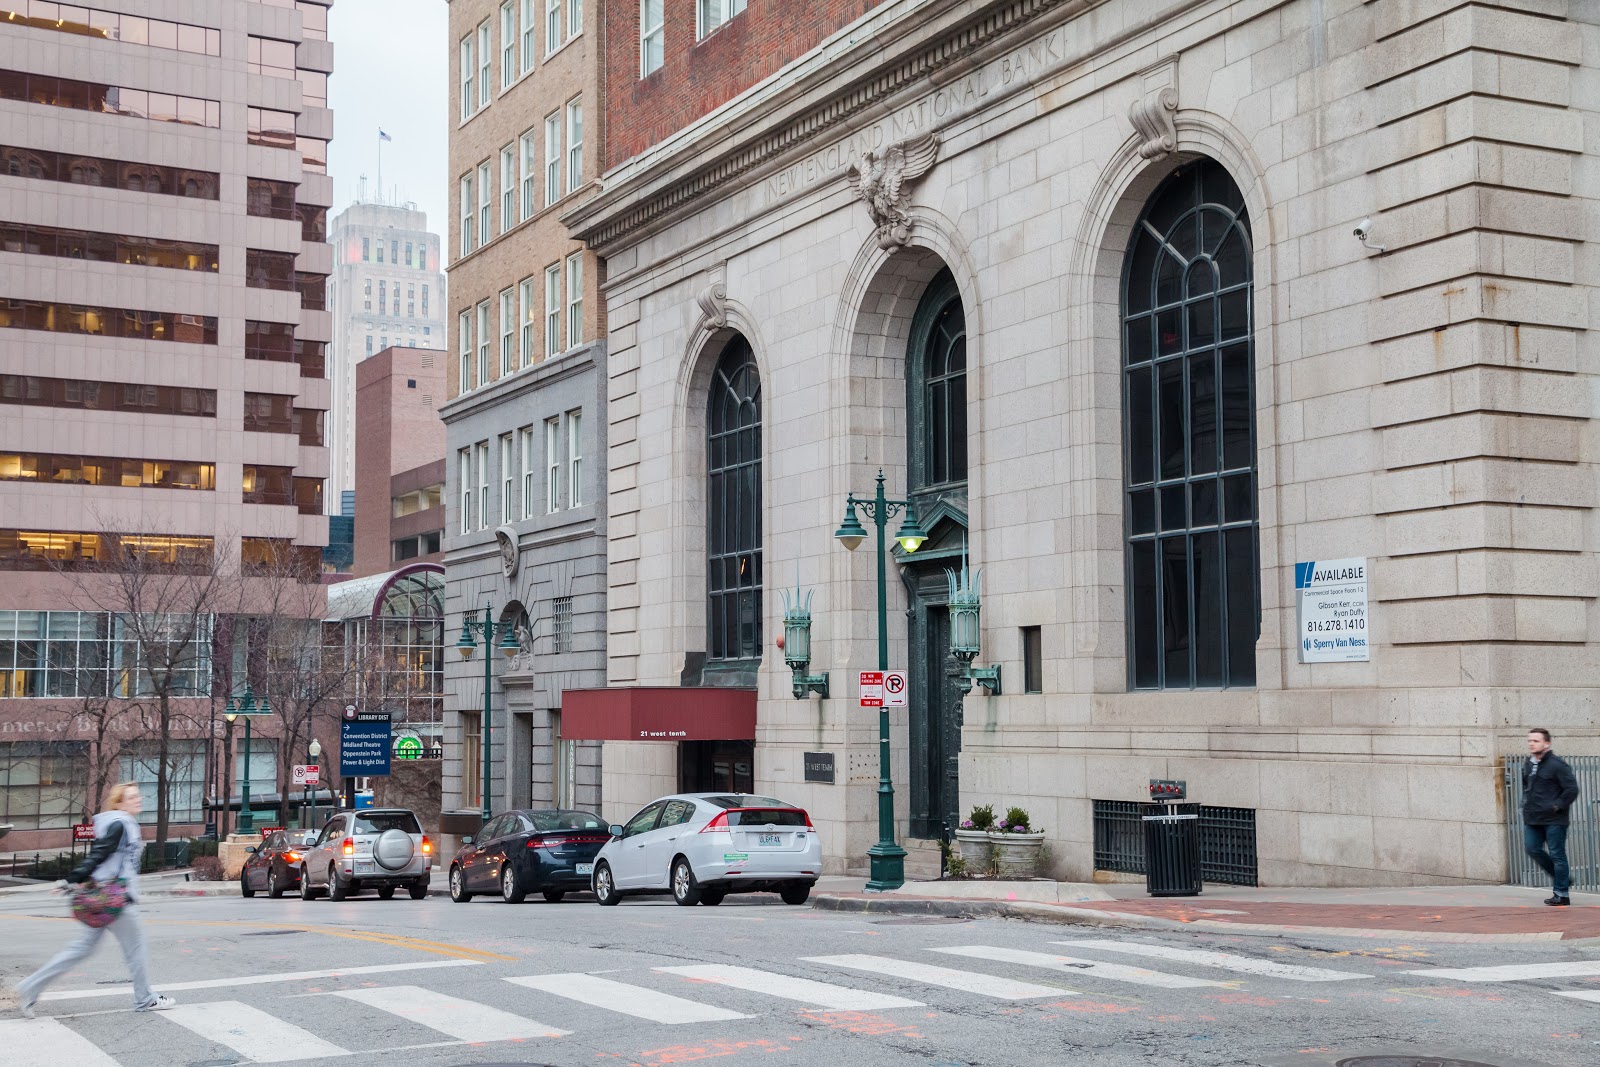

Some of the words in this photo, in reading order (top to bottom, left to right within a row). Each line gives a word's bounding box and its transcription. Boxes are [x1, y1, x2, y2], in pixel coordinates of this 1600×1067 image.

[768, 167, 798, 202] NEW
[807, 125, 883, 182] ENGLAND
[892, 72, 988, 140] NATIONAL
[1002, 34, 1060, 85] BANK
[1314, 567, 1363, 582] AVAILABLE
[1318, 602, 1338, 610] Gibson
[1334, 610, 1348, 618] Ryan
[1308, 618, 1364, 632] 816.278.1410
[1314, 638, 1334, 650] Sperry
[1336, 638, 1348, 647] Van
[1349, 637, 1366, 646] Ness
